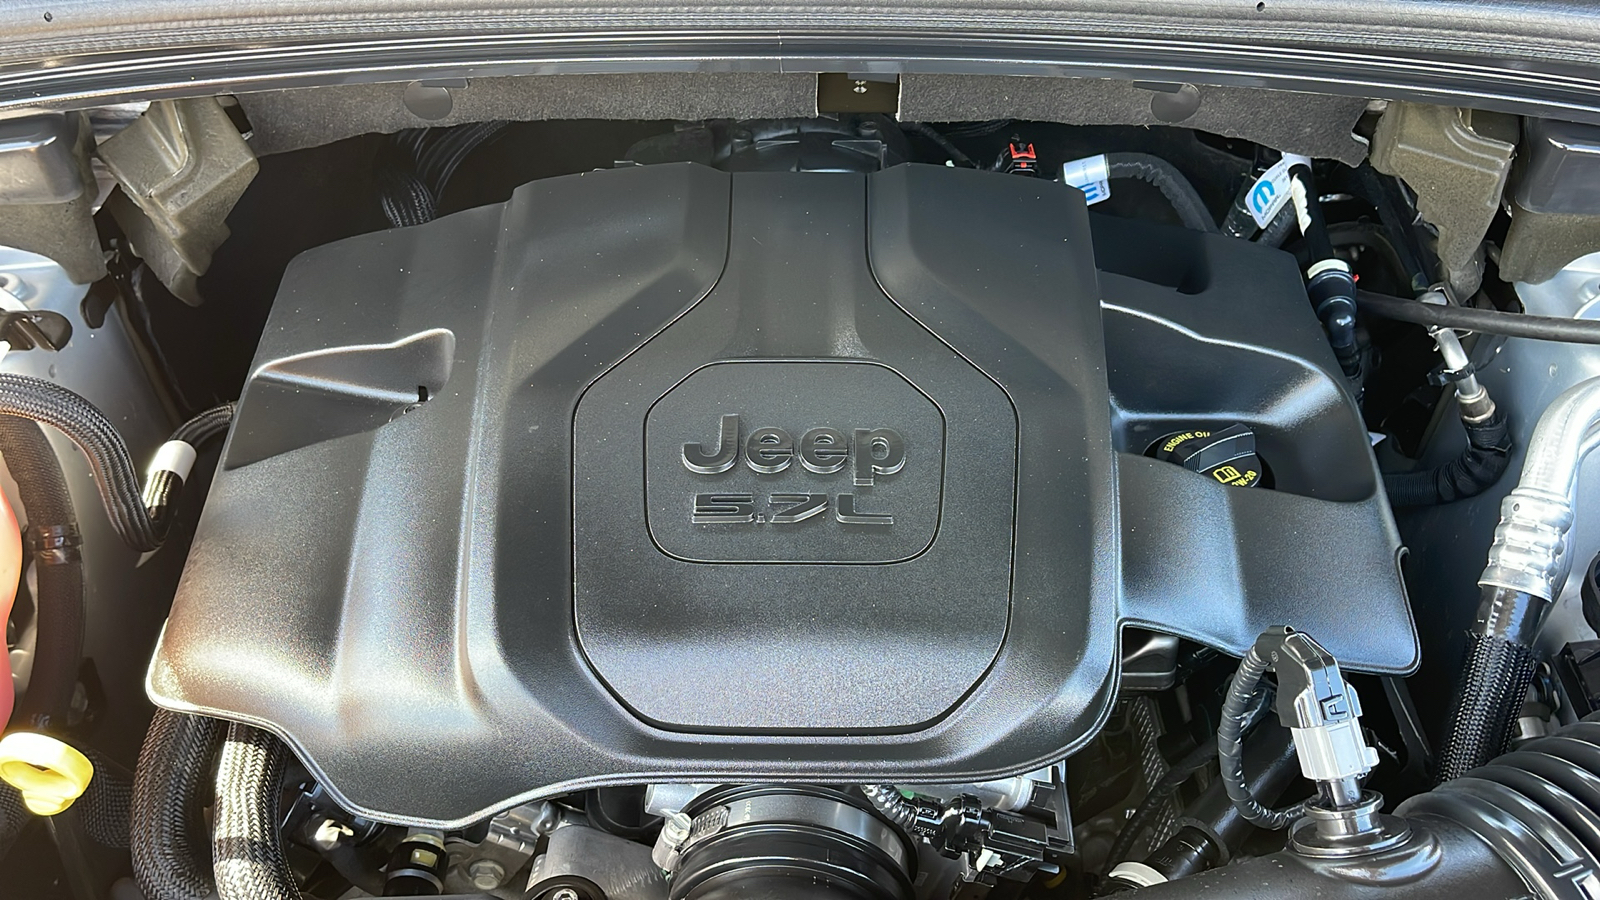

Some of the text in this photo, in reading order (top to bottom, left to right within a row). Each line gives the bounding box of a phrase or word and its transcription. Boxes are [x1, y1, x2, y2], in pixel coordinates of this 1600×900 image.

[681, 413, 906, 487] Jeep
[1163, 432, 1194, 452] ENGINE
[691, 492, 894, 524] 5.7L
